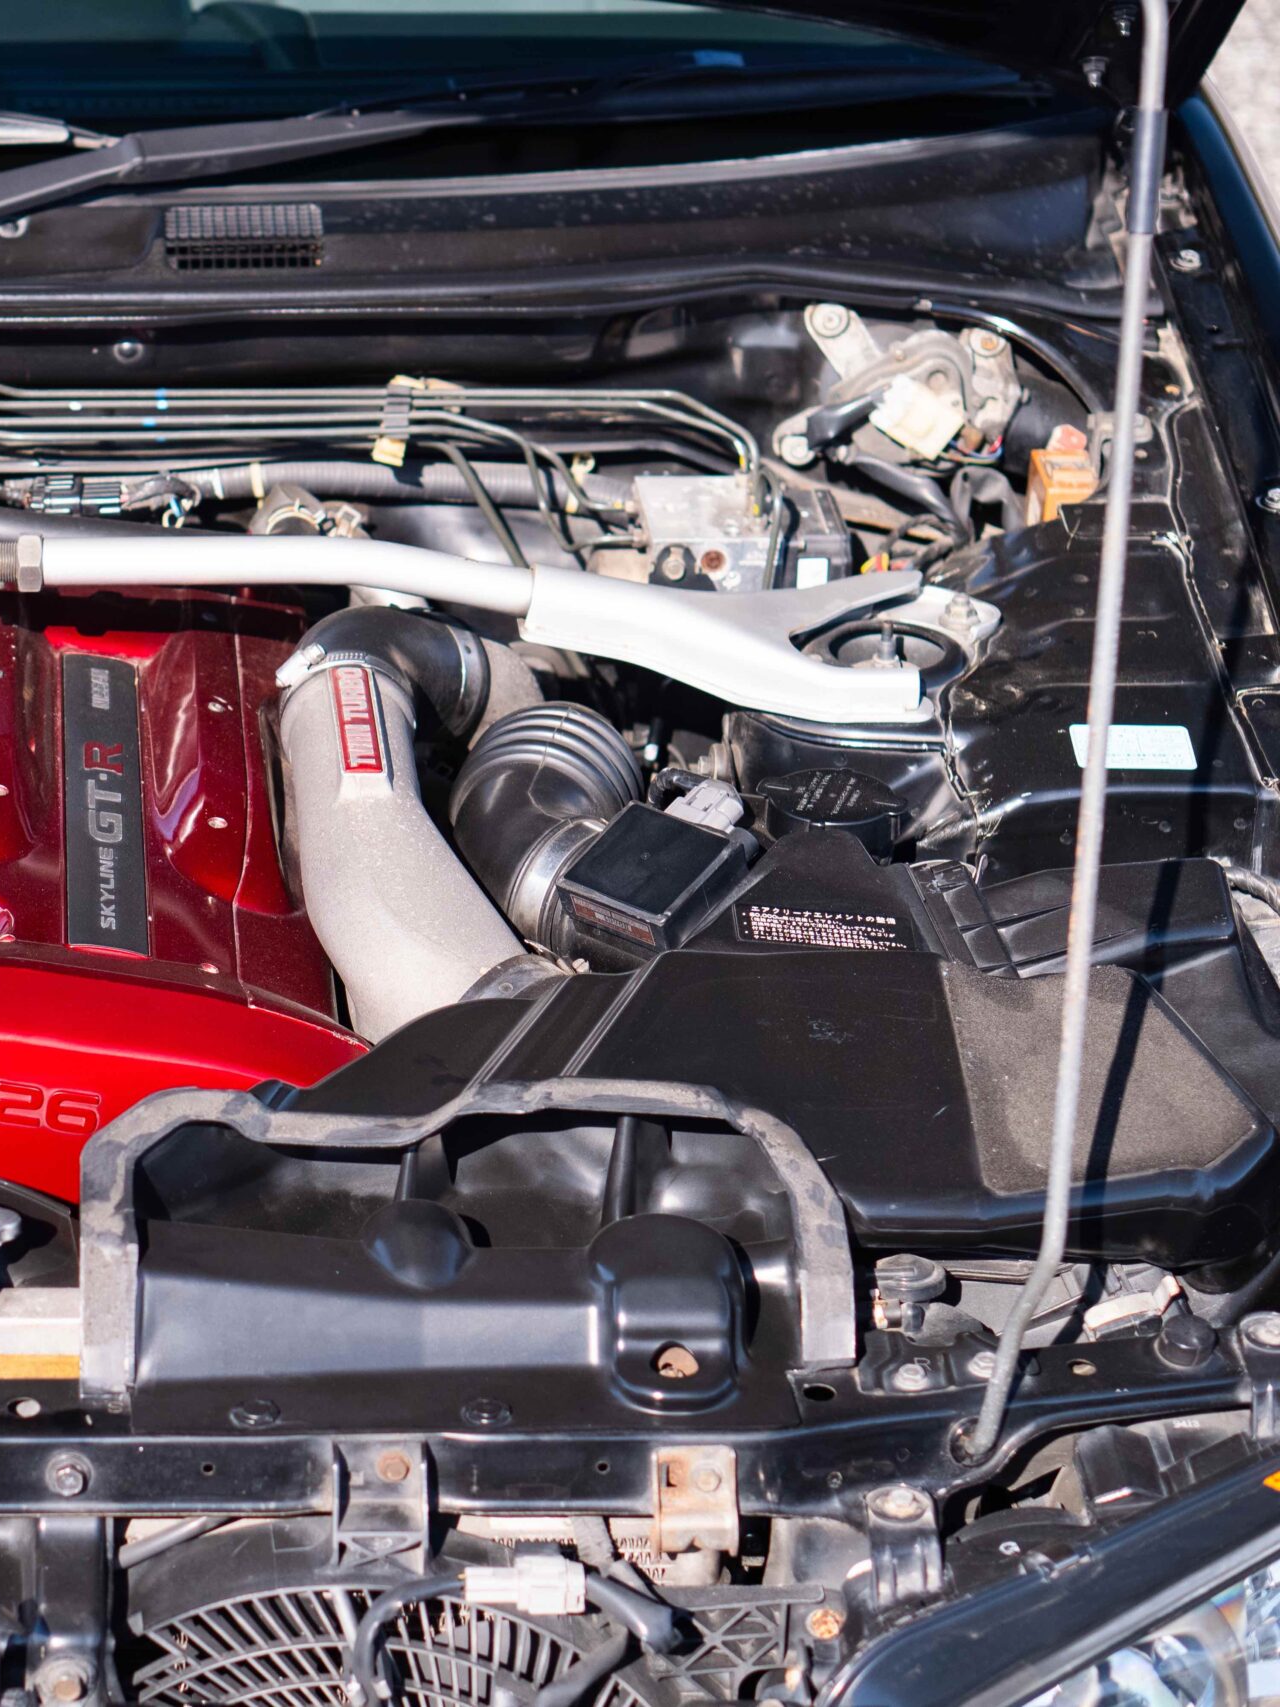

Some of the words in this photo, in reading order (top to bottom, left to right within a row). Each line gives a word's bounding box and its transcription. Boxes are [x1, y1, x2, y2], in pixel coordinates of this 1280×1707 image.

[336, 667, 370, 721] TURBO
[344, 723, 377, 768] TWIN
[99, 846, 116, 930] SKYLINE
